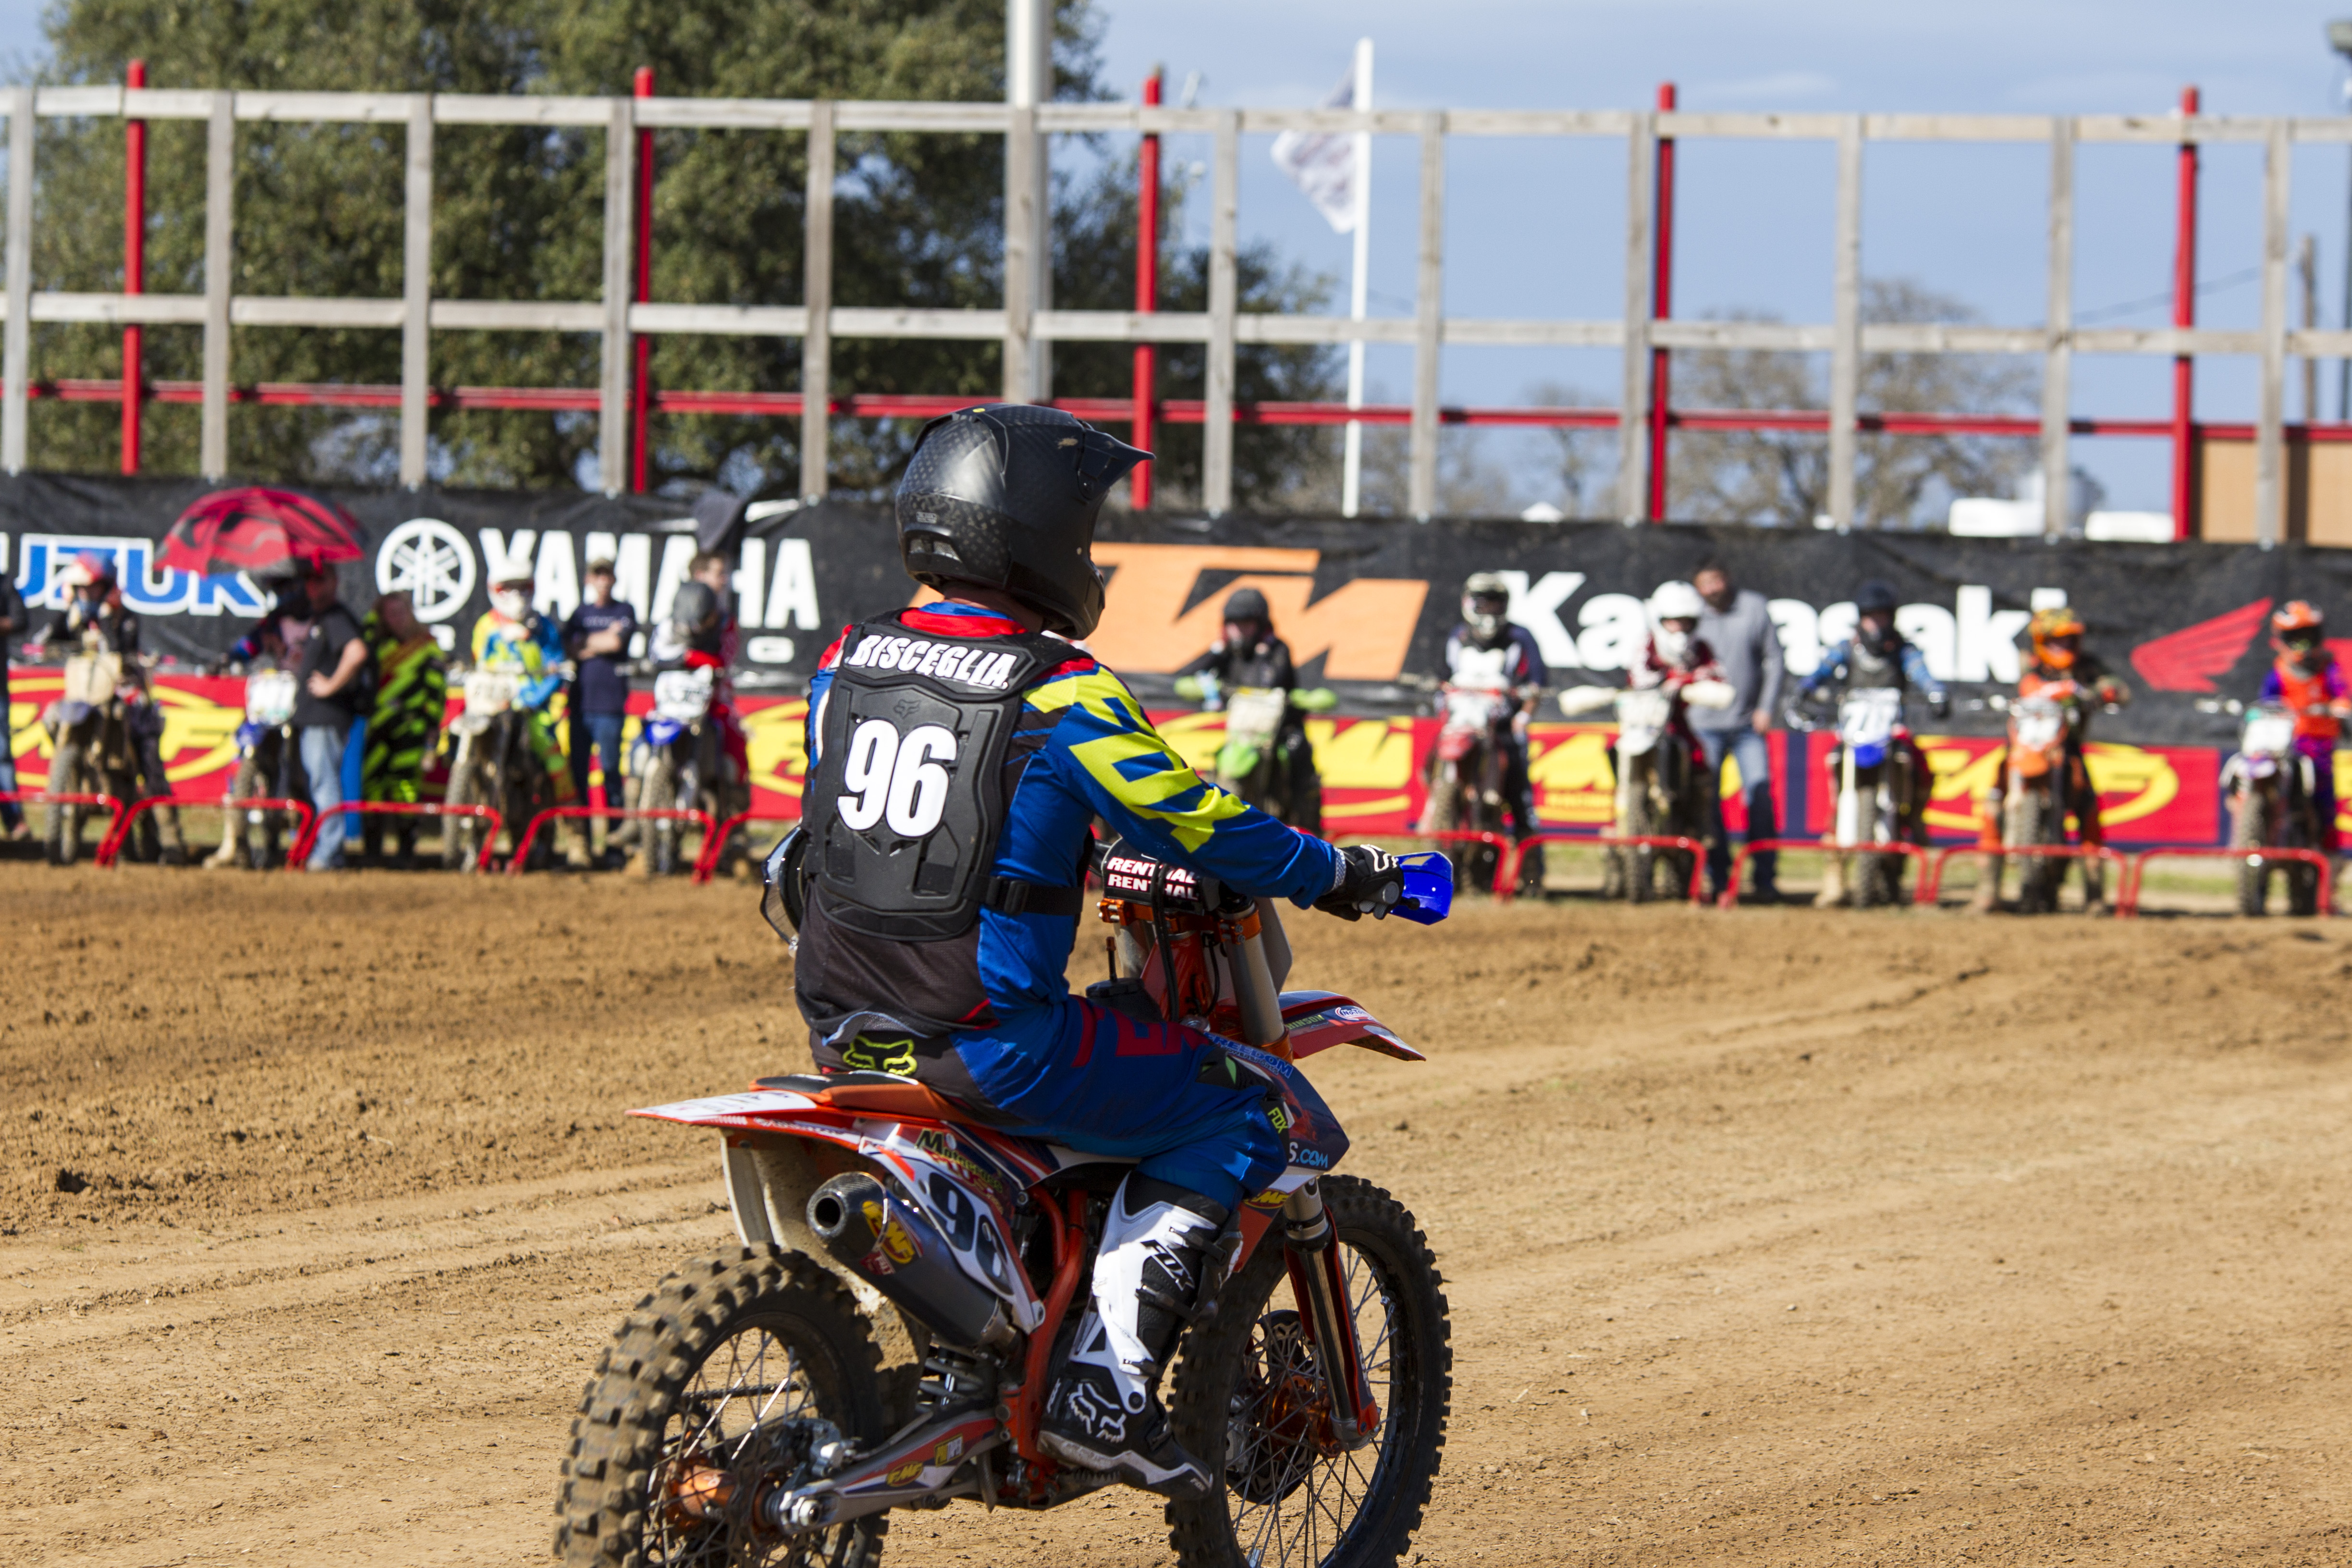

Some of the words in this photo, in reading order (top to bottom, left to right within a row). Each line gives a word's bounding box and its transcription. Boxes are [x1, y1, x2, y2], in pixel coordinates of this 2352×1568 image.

[848, 635, 1017, 689] BISCEGLIA
[837, 720, 958, 837] 96
[1267, 1107, 1288, 1134] FOX
